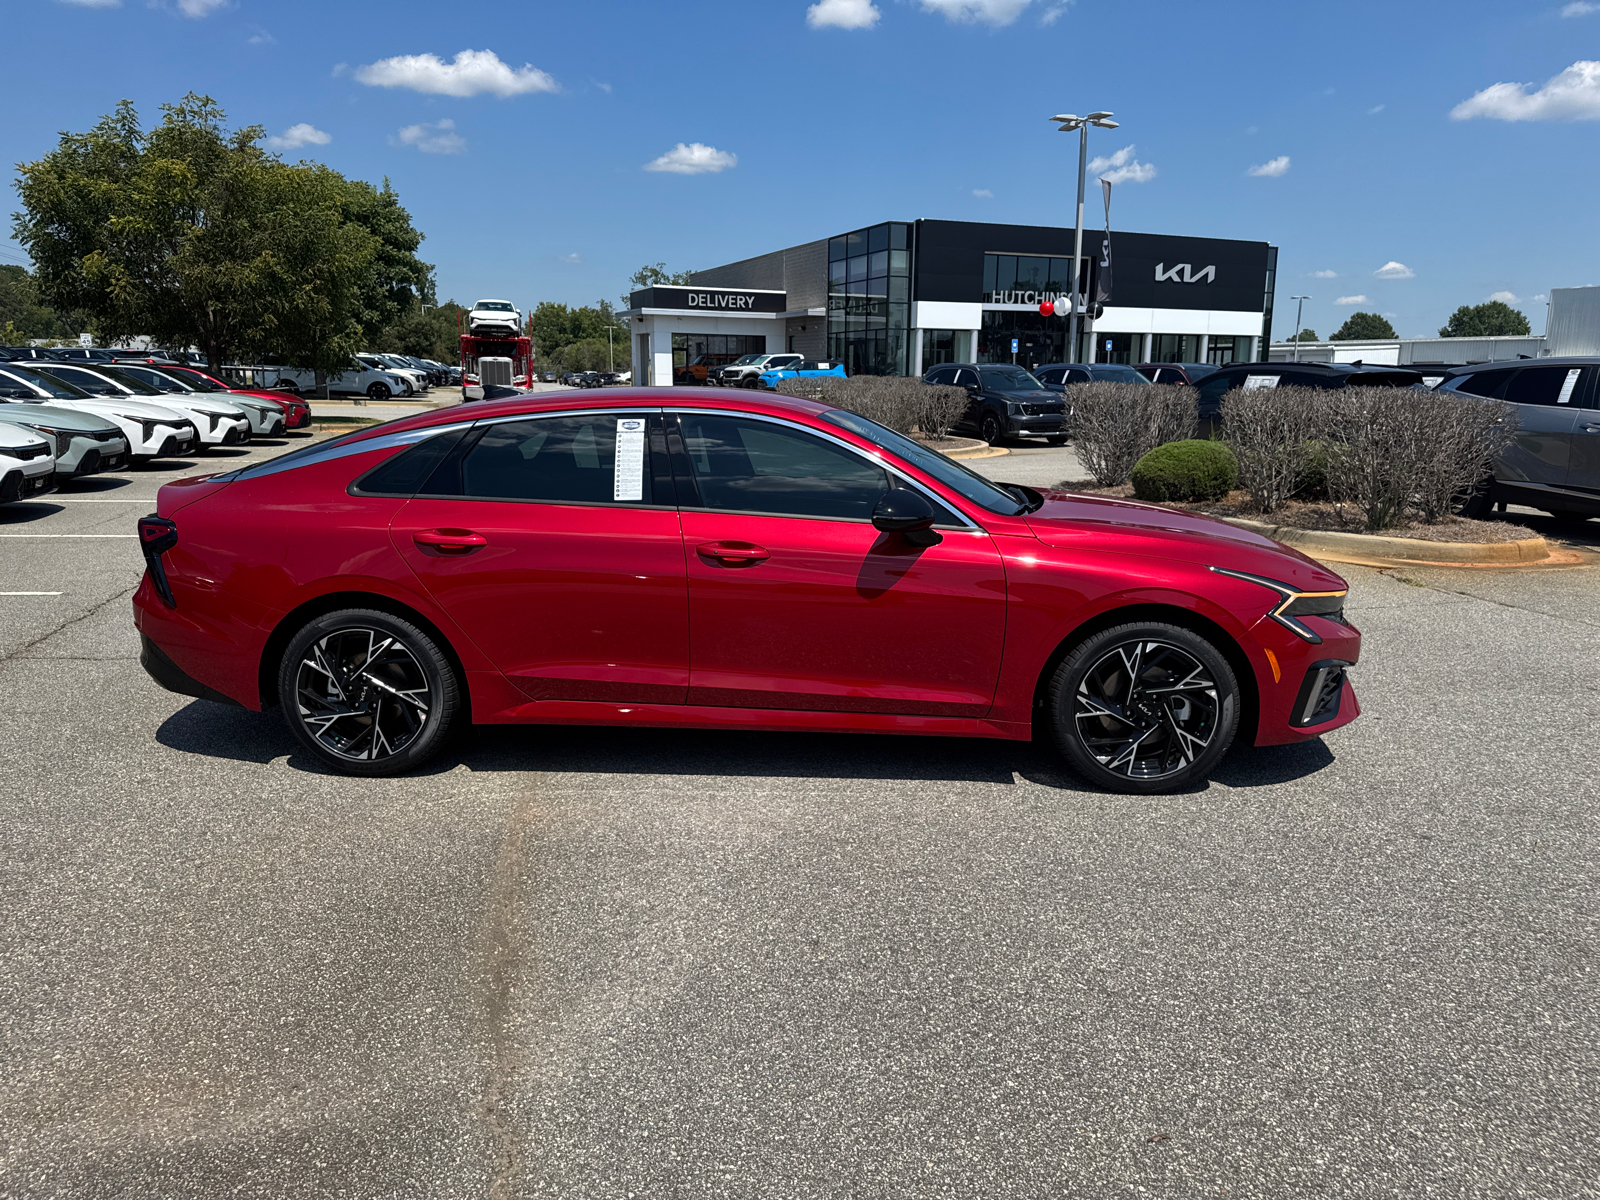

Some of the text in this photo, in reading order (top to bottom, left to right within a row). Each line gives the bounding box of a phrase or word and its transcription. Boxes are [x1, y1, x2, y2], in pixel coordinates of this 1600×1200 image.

[1155, 262, 1216, 284] KIA
[688, 293, 755, 308] DELIVERY
[992, 290, 1088, 306] HUTCHINN
